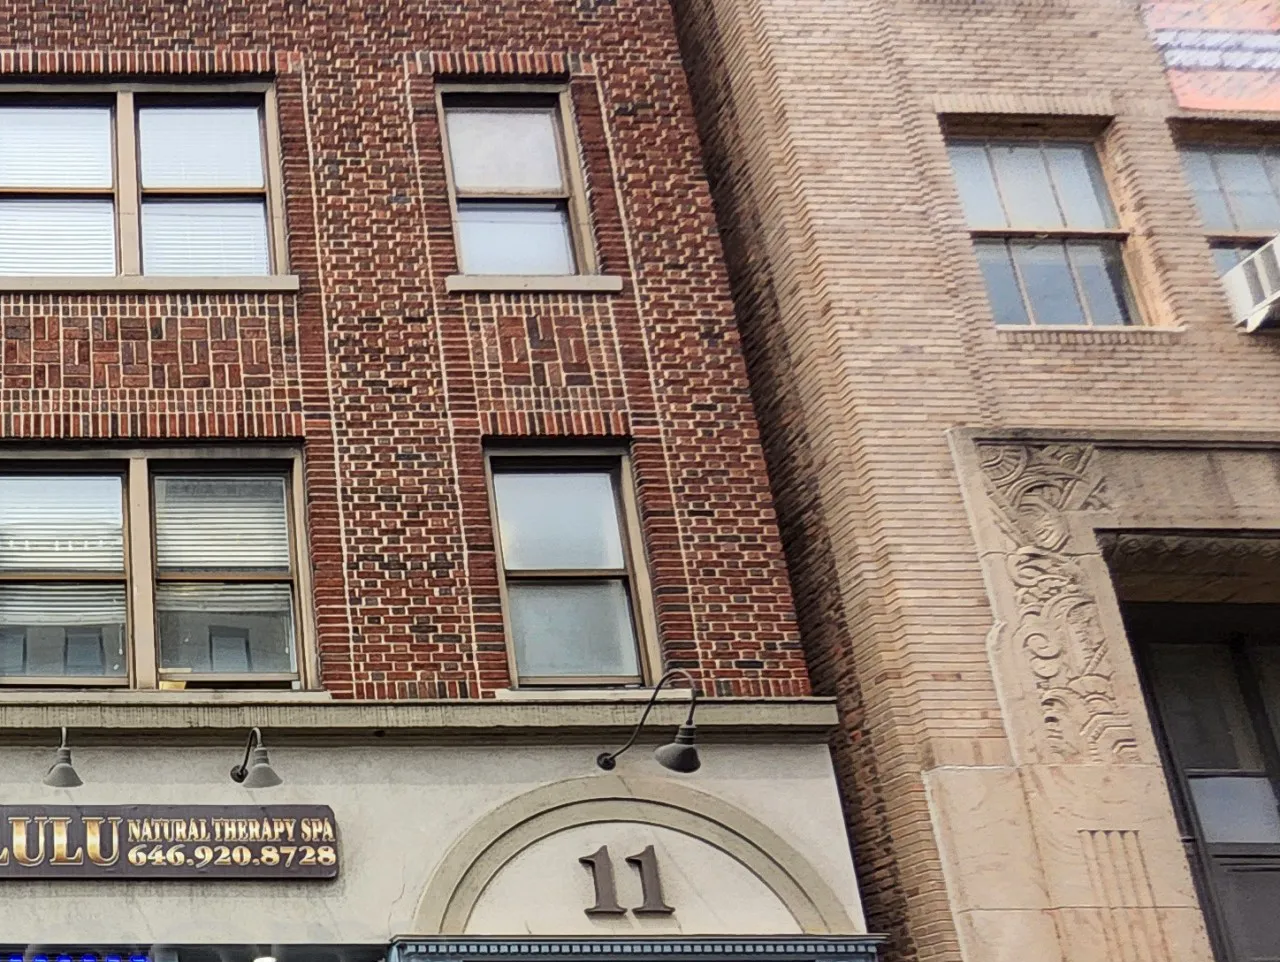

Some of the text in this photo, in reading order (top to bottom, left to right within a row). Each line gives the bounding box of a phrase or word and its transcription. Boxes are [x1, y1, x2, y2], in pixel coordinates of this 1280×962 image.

[127, 818, 336, 843] NATURAL THERAPY SPA
[127, 843, 337, 868] 646.920.8728
[578, 844, 676, 916] 11
